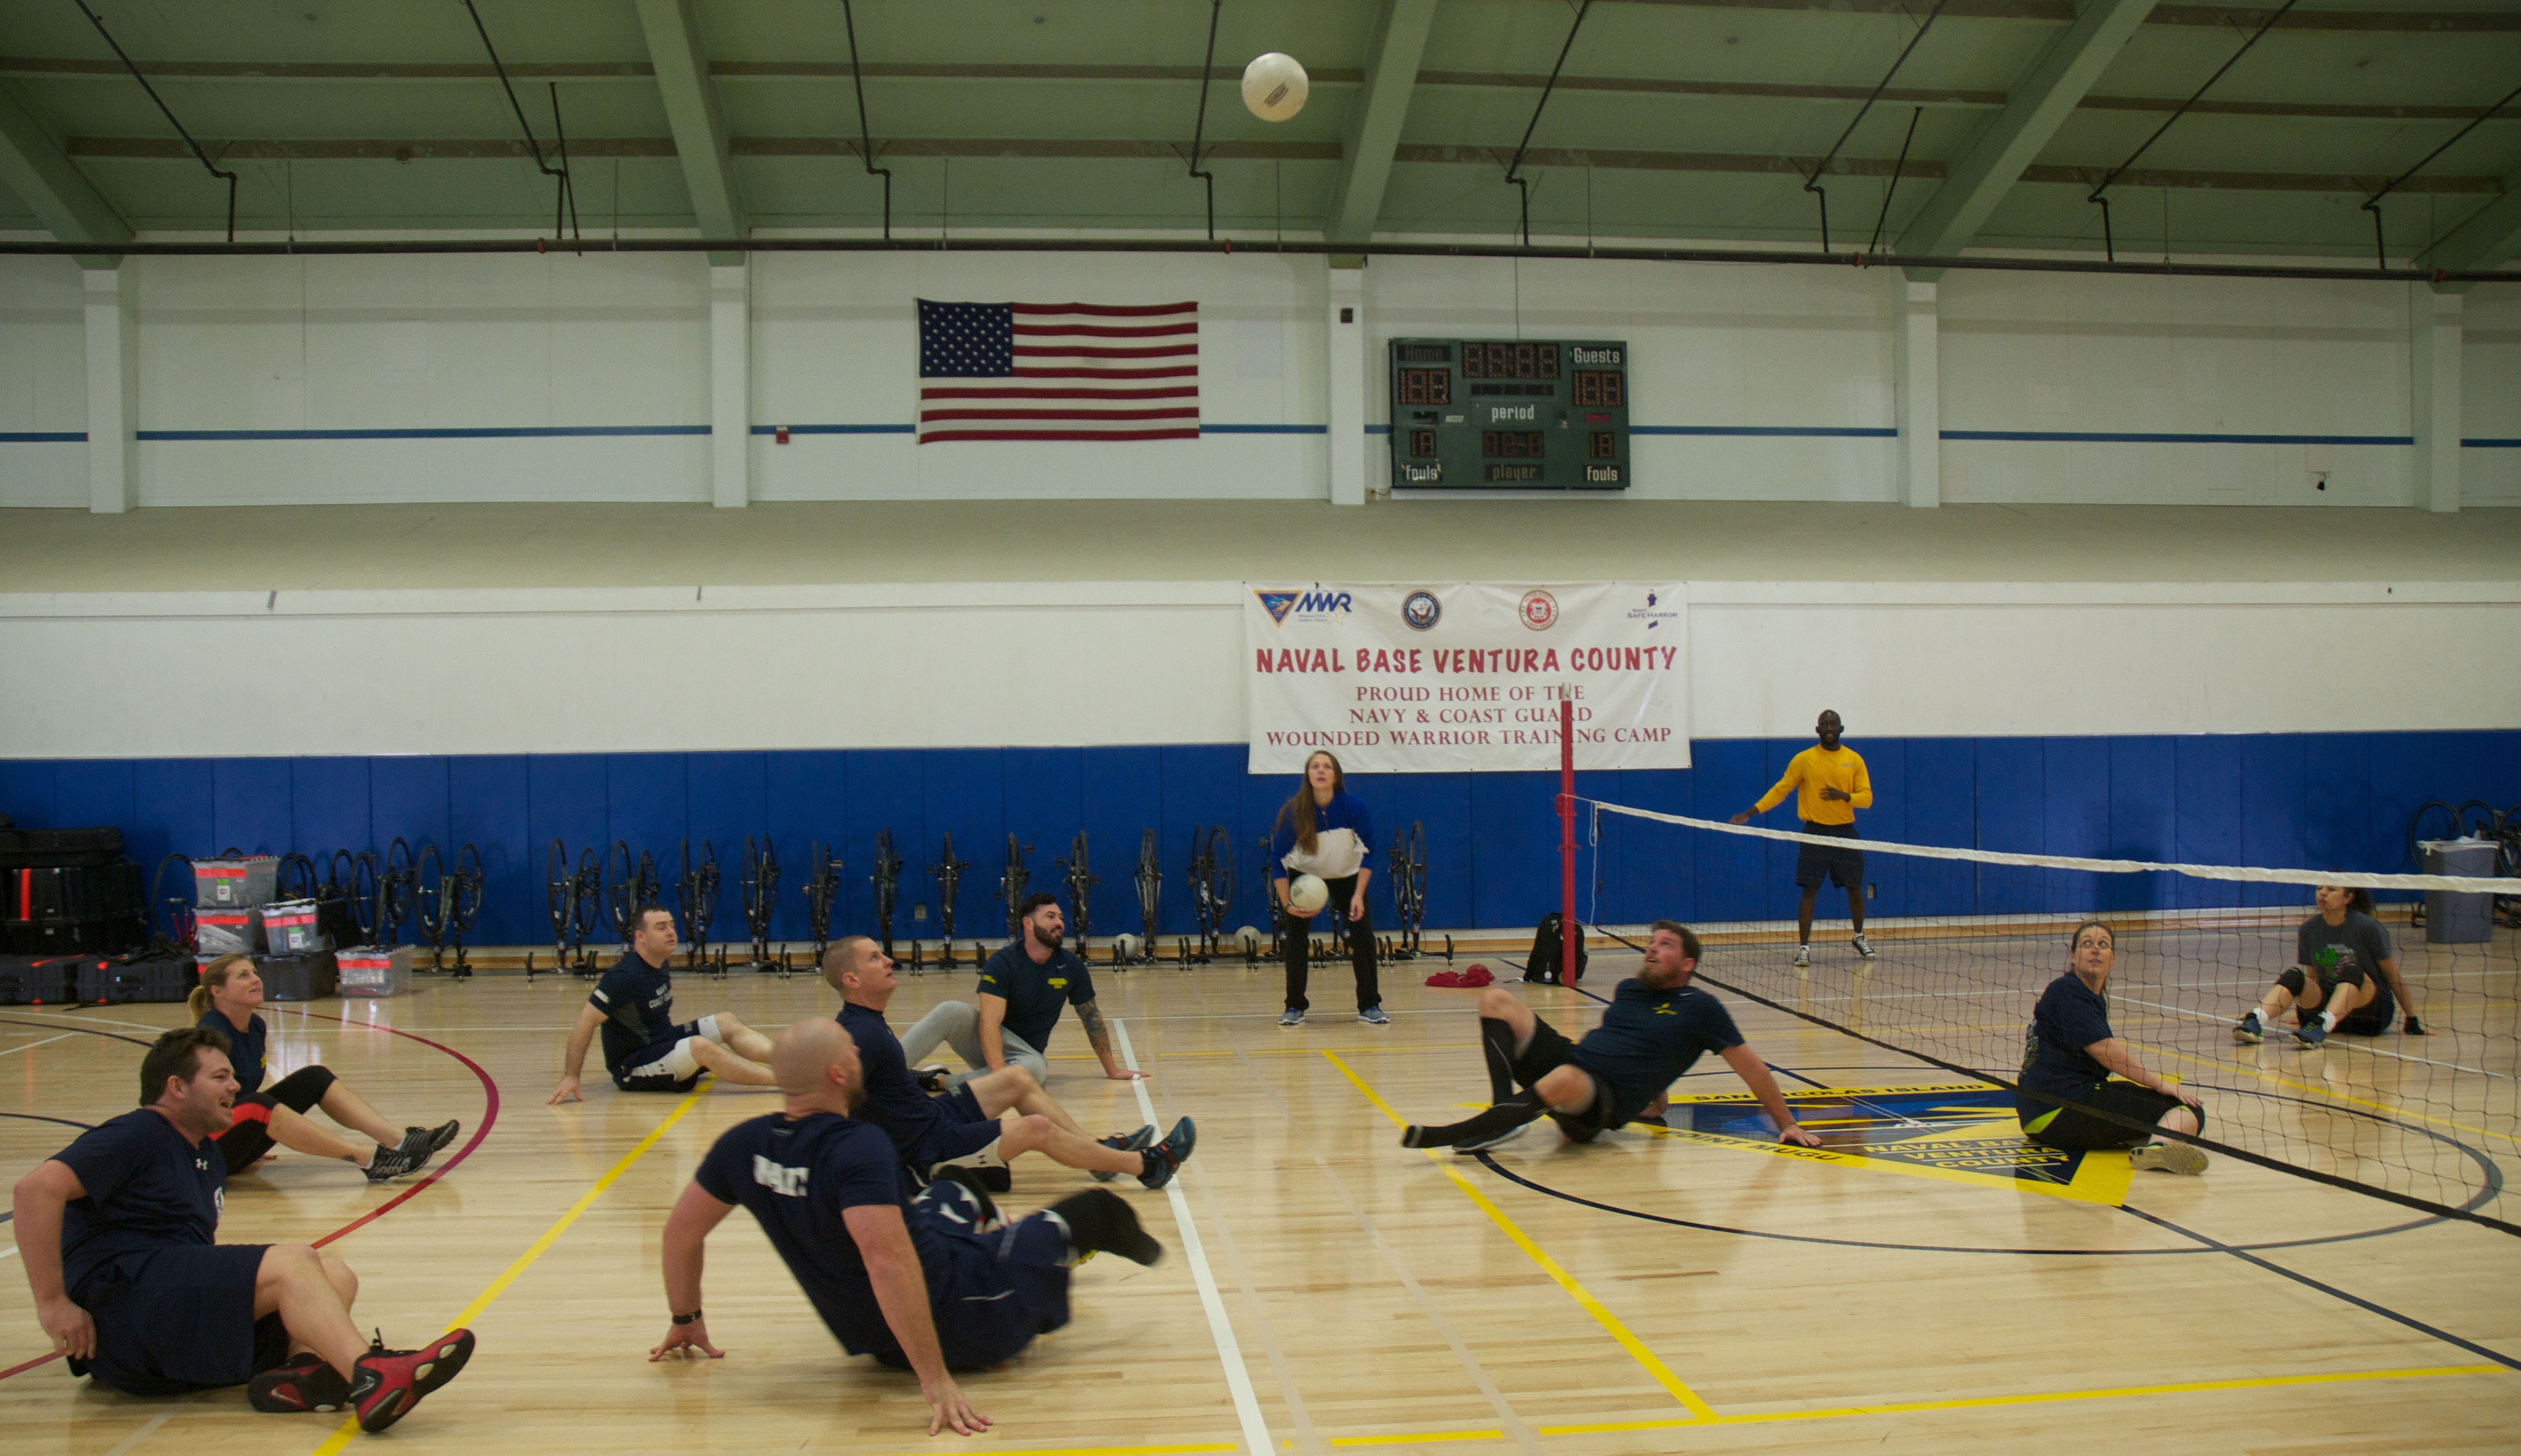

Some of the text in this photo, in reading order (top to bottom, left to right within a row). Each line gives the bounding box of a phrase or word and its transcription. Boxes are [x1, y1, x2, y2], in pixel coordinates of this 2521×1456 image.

[1574, 347, 1621, 363] Guests
[1492, 404, 1535, 422] period
[1406, 464, 1438, 481] fouls
[1493, 464, 1536, 481] player
[1587, 465, 1618, 481] fouls
[1295, 592, 1352, 612] MWR
[1257, 646, 1677, 674] NAVAL BASE VENTURA COUNTY
[1356, 686, 1430, 701] PROUD
[1439, 686, 1500, 701] HOME
[1509, 686, 1535, 701] OF
[1349, 707, 1592, 723] NAVY & COAST GUAD
[1267, 727, 1671, 746] WOUNDED WARRIOR TRAINNG CAMP
[1884, 1084, 1985, 1093] ISLAND
[1657, 1130, 1844, 1160] POINT MUGU
[1863, 1139, 2039, 1153] NAVAL BA
[1903, 1146, 2065, 1159] VENTURA
[1936, 1154, 2070, 1168] COUNTY
